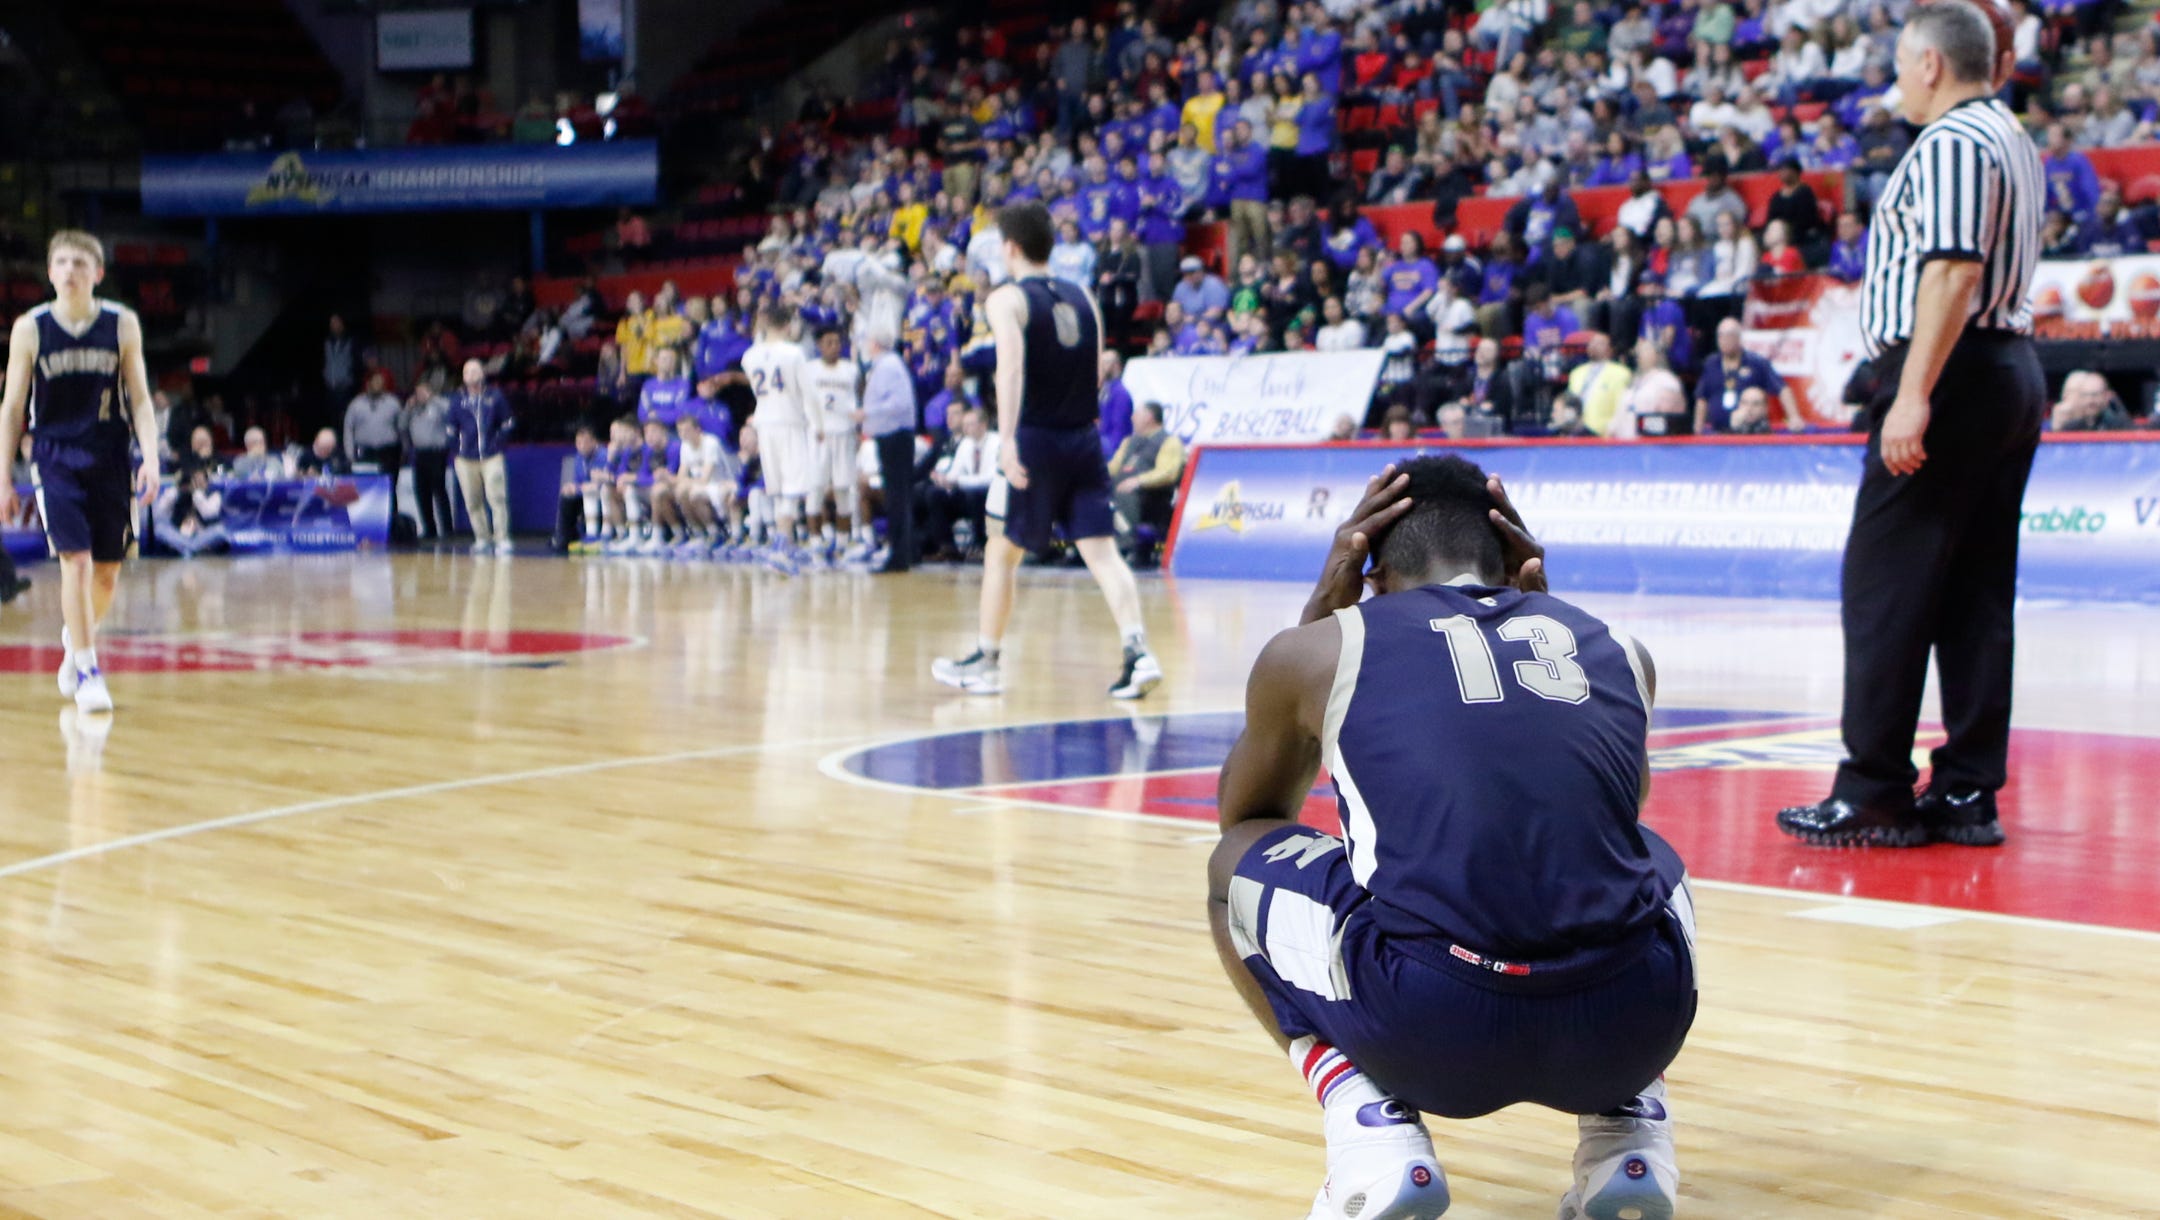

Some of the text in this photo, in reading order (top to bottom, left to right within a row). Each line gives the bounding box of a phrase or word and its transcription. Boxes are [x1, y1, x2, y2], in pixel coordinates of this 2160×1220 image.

[376, 164, 545, 188] CHAMPIONSHIPS
[752, 366, 785, 396] 24
[1211, 405, 1325, 440] BASKETBALL
[1209, 500, 1285, 520] NYSPHSAA
[1596, 483, 1734, 511] BASKETBALL
[1676, 526, 1794, 549] ASSOCIATION
[1429, 613, 1590, 706] 13
